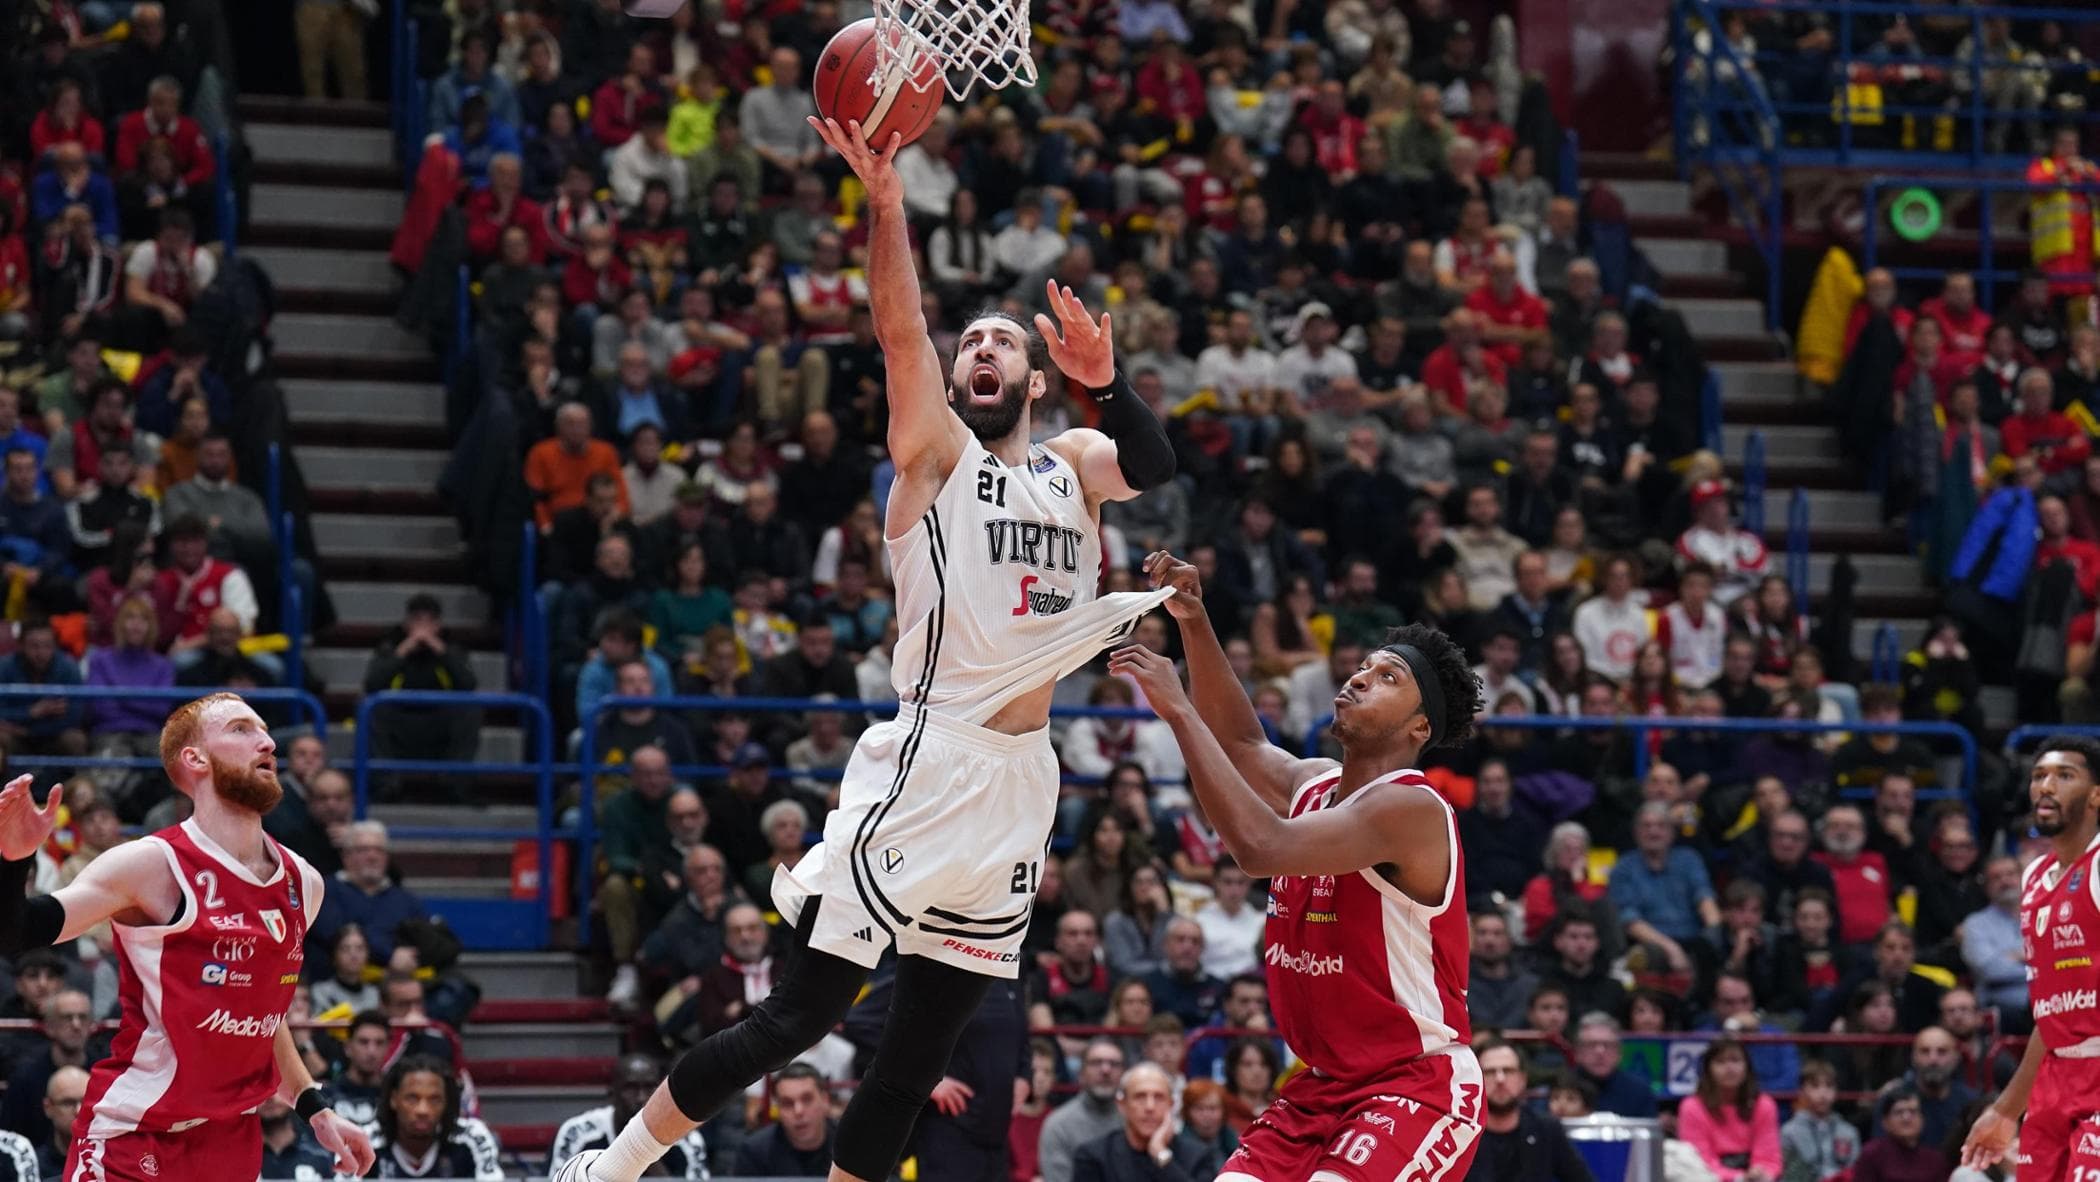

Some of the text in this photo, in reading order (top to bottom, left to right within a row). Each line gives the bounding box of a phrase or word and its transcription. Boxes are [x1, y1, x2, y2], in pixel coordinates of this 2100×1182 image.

[977, 469, 1007, 508] 21
[984, 519, 1084, 574] VIRTU
[195, 869, 226, 910] 2
[1010, 861, 1038, 894] 21
[209, 913, 246, 930] EA7
[942, 938, 1020, 963] PENSKECA
[229, 971, 252, 982] Group
[197, 1008, 287, 1038] MediaW
[1329, 1129, 1378, 1167] 16
